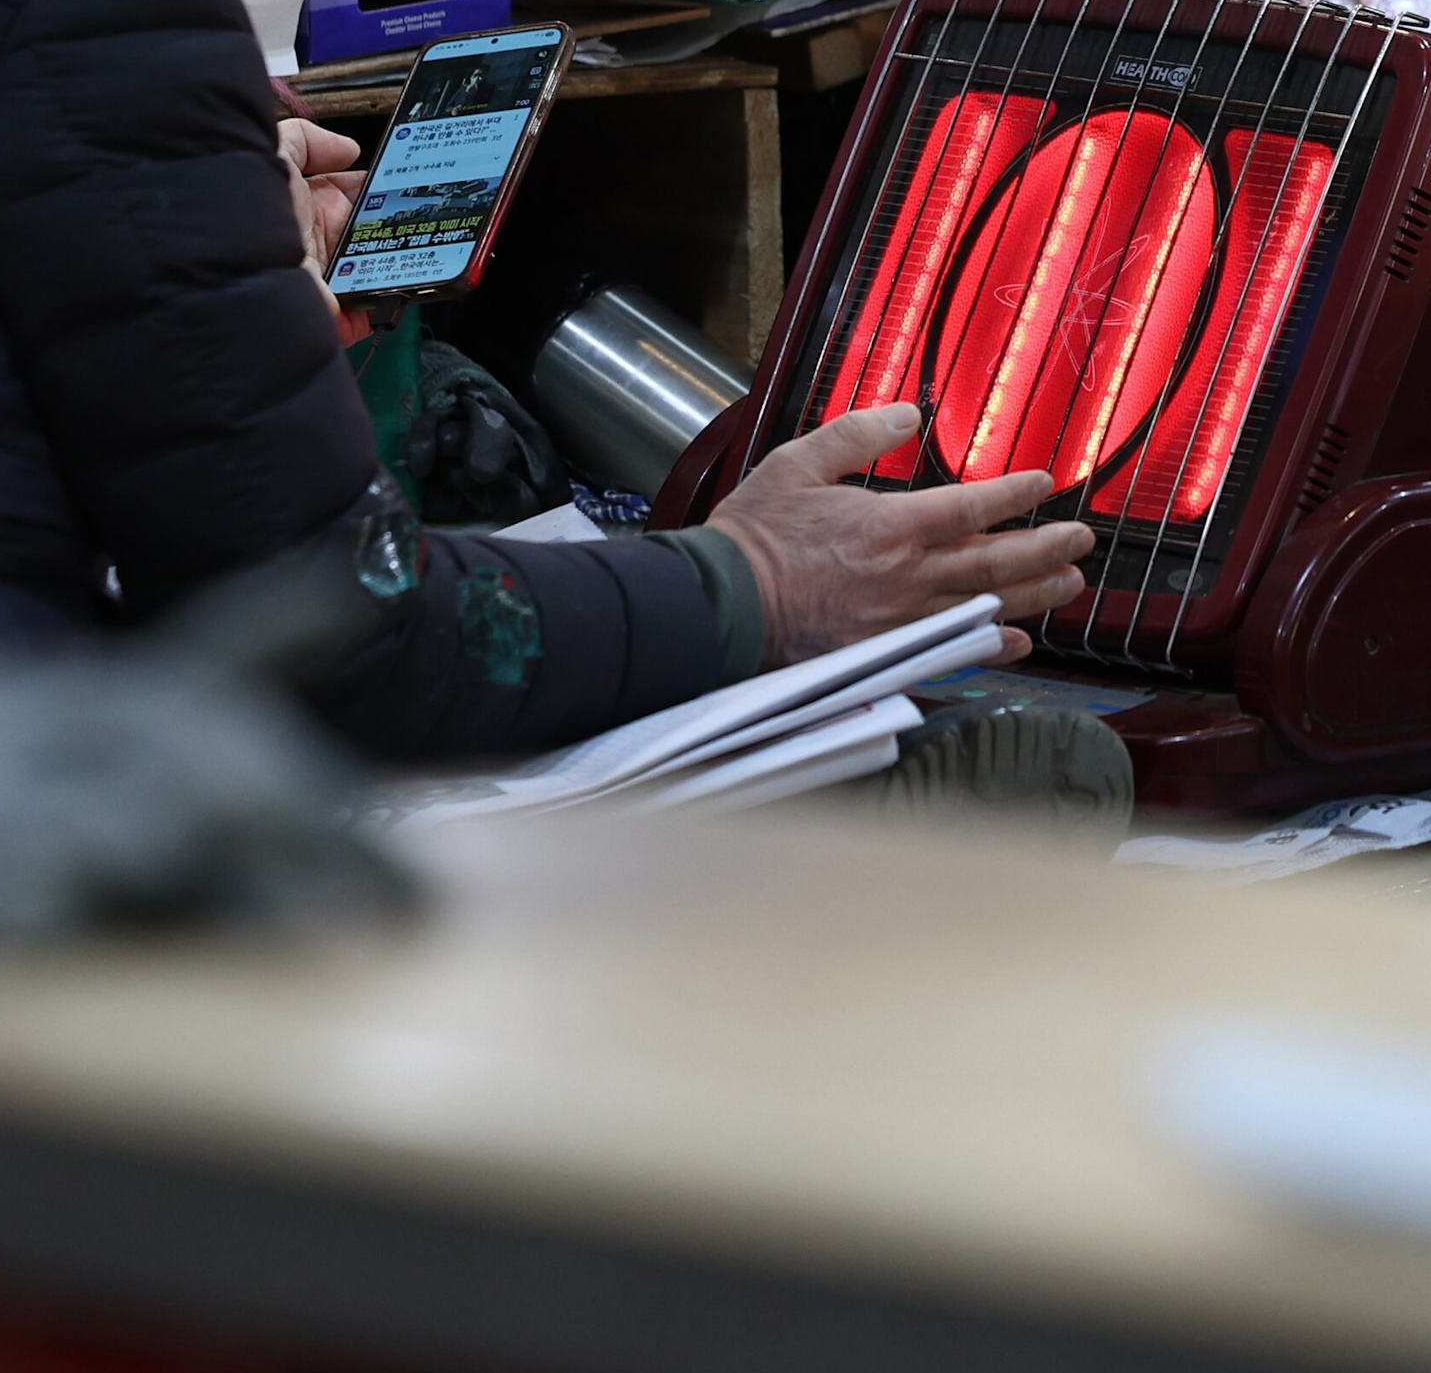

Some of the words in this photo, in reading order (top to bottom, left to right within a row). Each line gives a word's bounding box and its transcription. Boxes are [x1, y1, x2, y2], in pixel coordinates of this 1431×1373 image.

[369, 196, 384, 204] SBS
[351, 229, 371, 242] 영국
[396, 224, 416, 237] 미국
[416, 221, 436, 233] 32층
[345, 237, 405, 255] 한국에서는?
